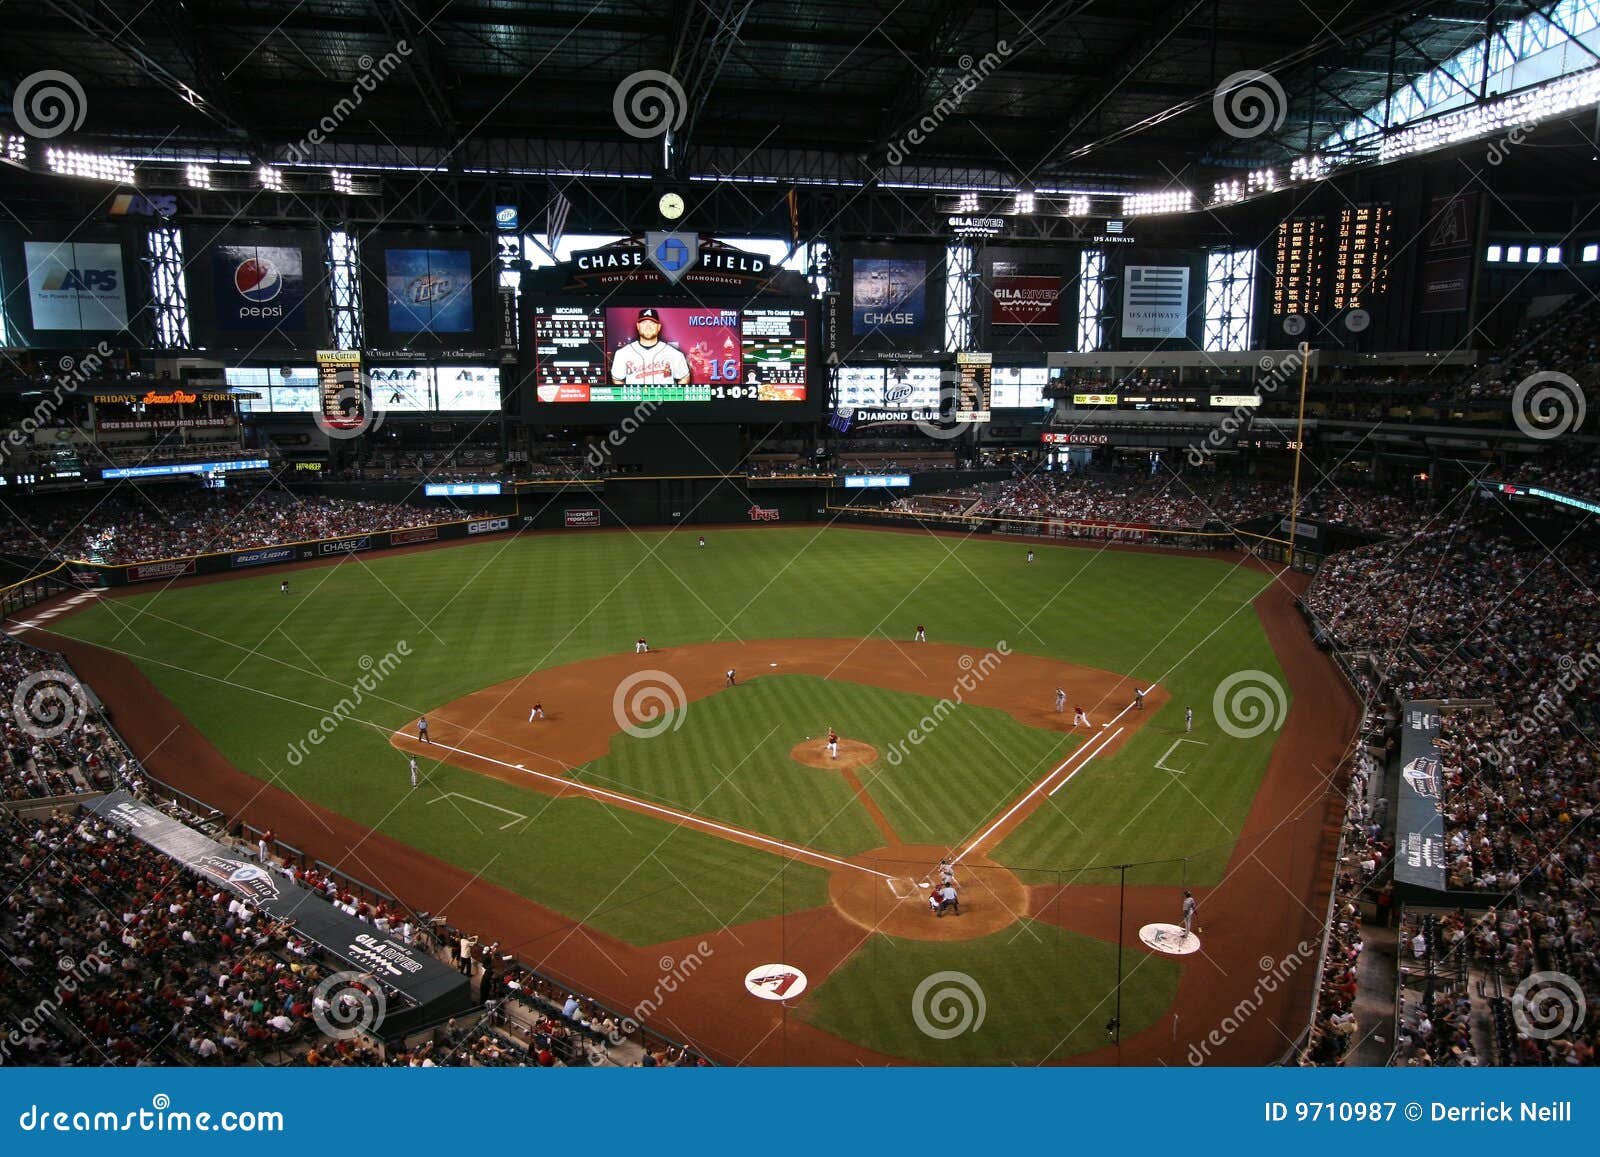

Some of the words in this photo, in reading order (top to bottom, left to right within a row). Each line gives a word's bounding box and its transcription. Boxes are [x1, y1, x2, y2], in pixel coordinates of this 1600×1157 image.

[948, 217, 972, 227] GILA
[972, 218, 1004, 227] RIVER
[578, 252, 642, 270] CHASE
[703, 254, 764, 273] FIELD
[60, 268, 117, 291] APS
[602, 275, 624, 283] HOME
[686, 275, 742, 285] DIAMONDBACKS
[993, 289, 1021, 299] GILA
[1022, 289, 1059, 300] RIVER
[239, 305, 282, 319] pepsi
[688, 316, 737, 326] MCCANN
[864, 313, 914, 325] CHASE
[710, 359, 738, 381] 16
[202, 393, 237, 401] SPORTS
[716, 386, 725, 399] 1
[732, 386, 741, 399] 0
[748, 386, 757, 399] 2
[857, 410, 908, 421] DIAMOND
[911, 410, 940, 421] CLUB
[469, 519, 509, 533] GEICO
[323, 540, 357, 552] CHASE
[237, 552, 259, 563] BUD
[260, 550, 291, 560] LIGHT
[208, 859, 236, 872] CHASE
[249, 879, 272, 896] FIELD
[355, 934, 387, 953] GILA
[381, 947, 423, 973] RIVER
